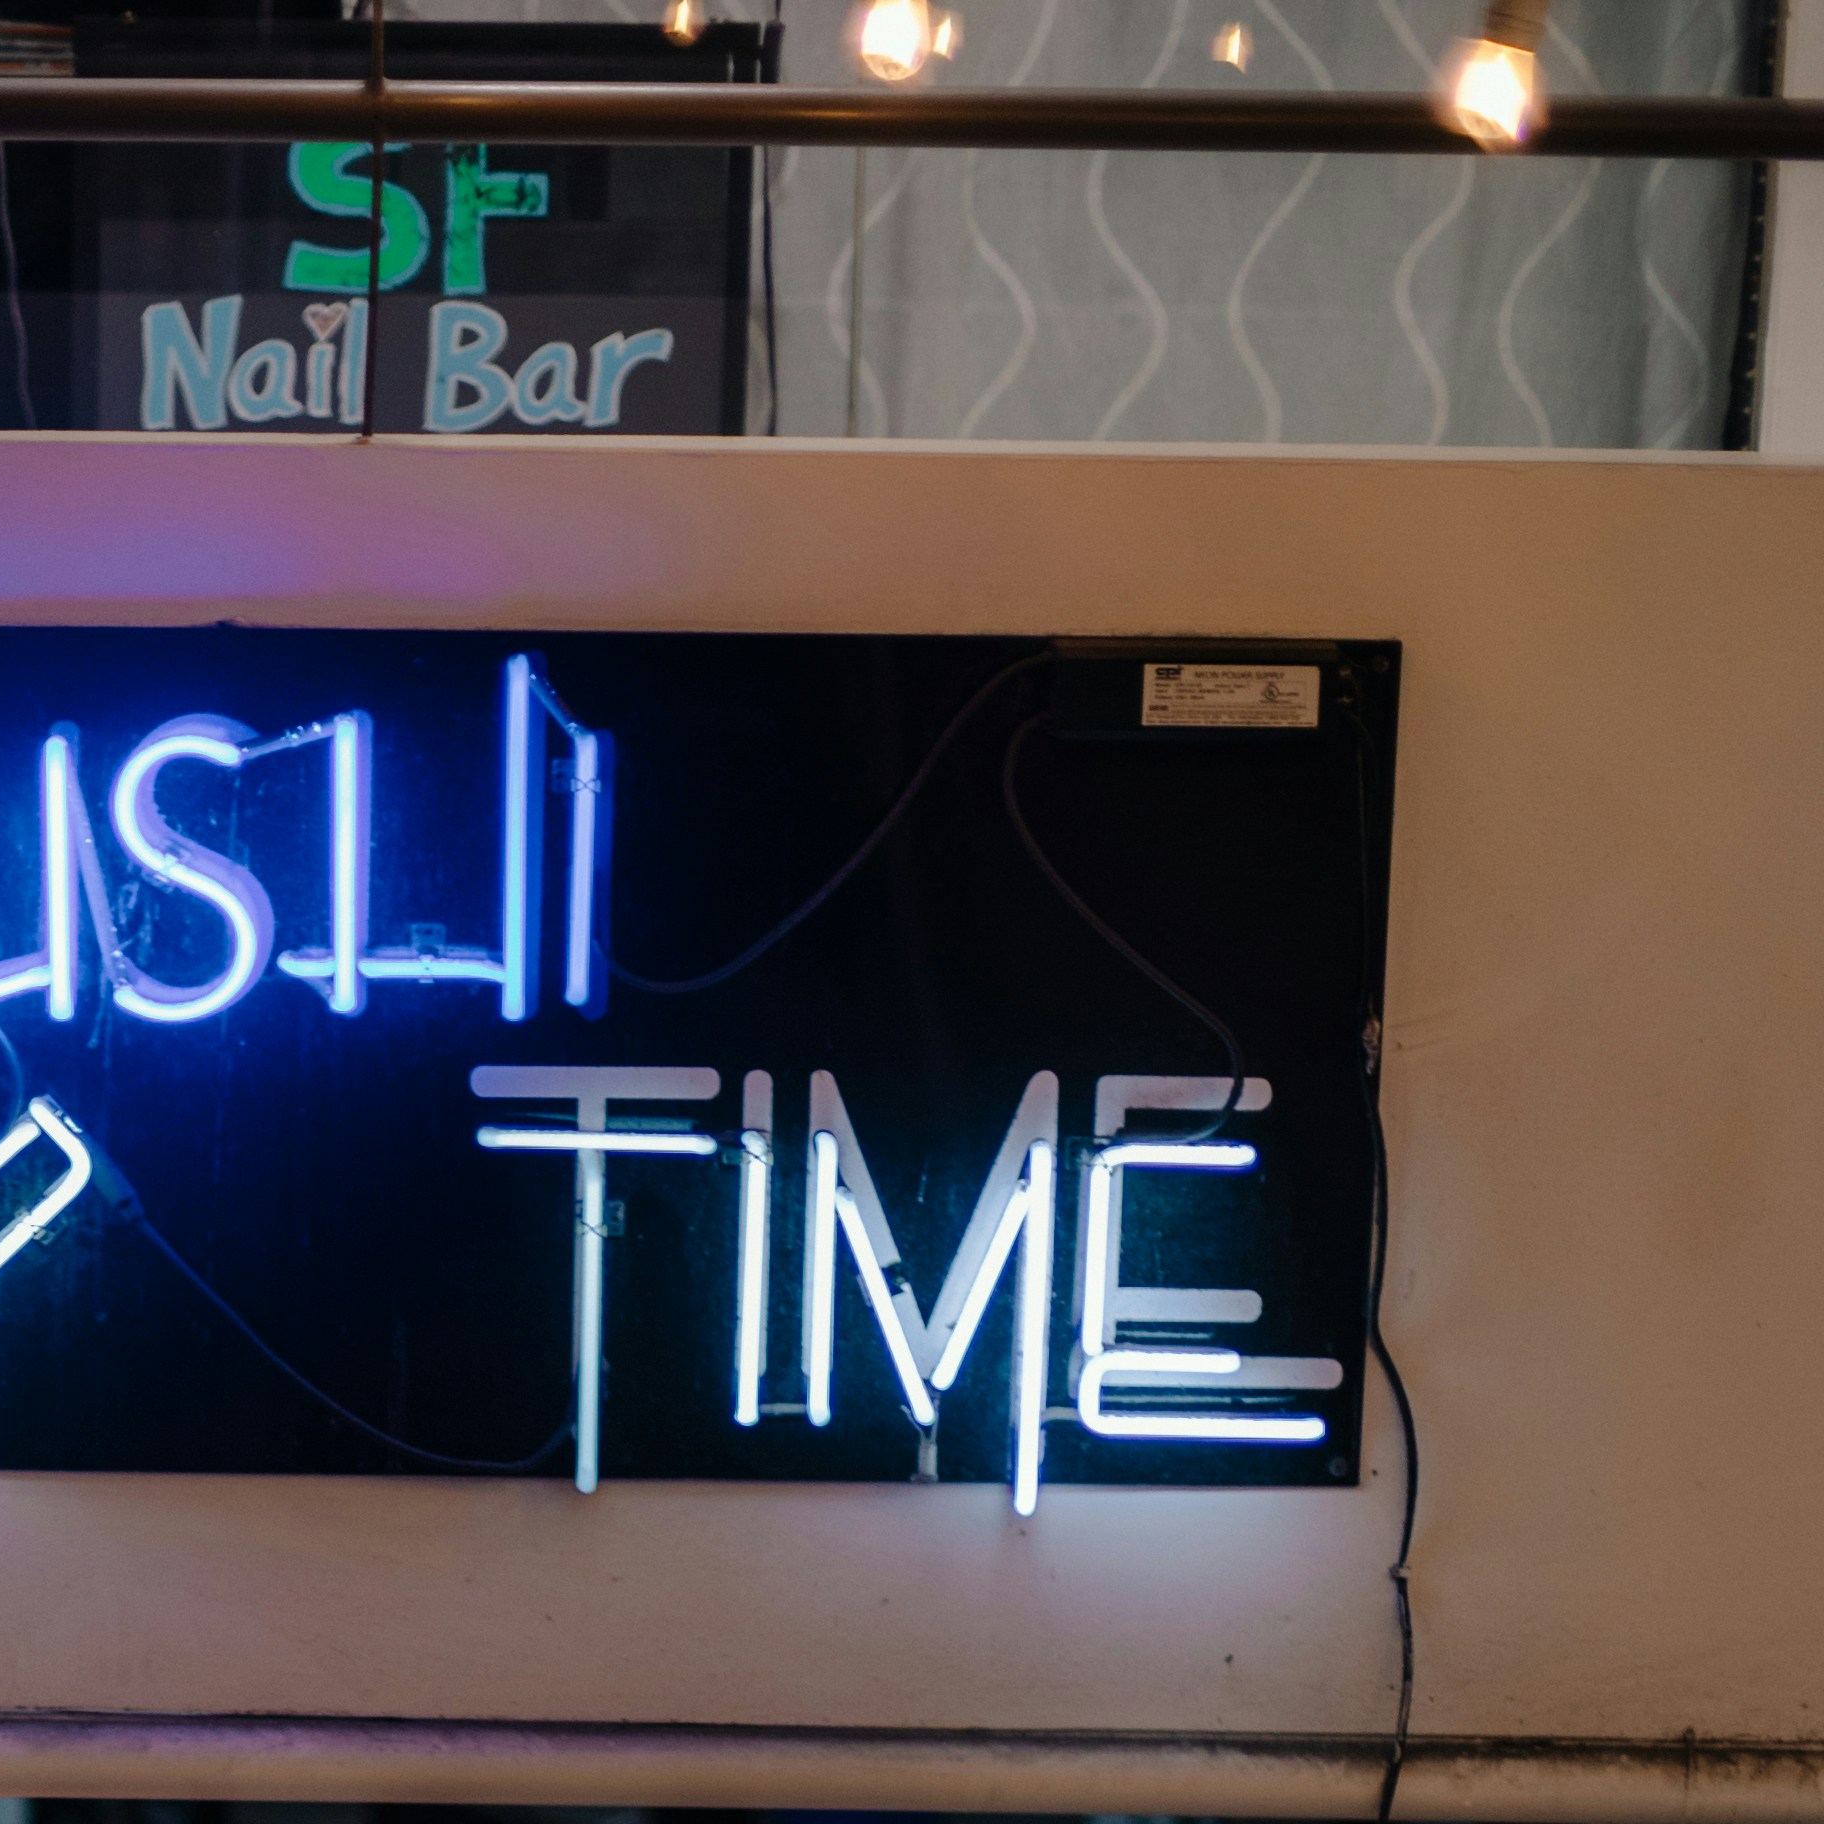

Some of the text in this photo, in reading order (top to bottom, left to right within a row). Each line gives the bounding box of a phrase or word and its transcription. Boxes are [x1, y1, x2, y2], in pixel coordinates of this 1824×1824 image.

[140, 294, 674, 434] Nail Bar
[470, 1065, 1344, 1516] TIME
